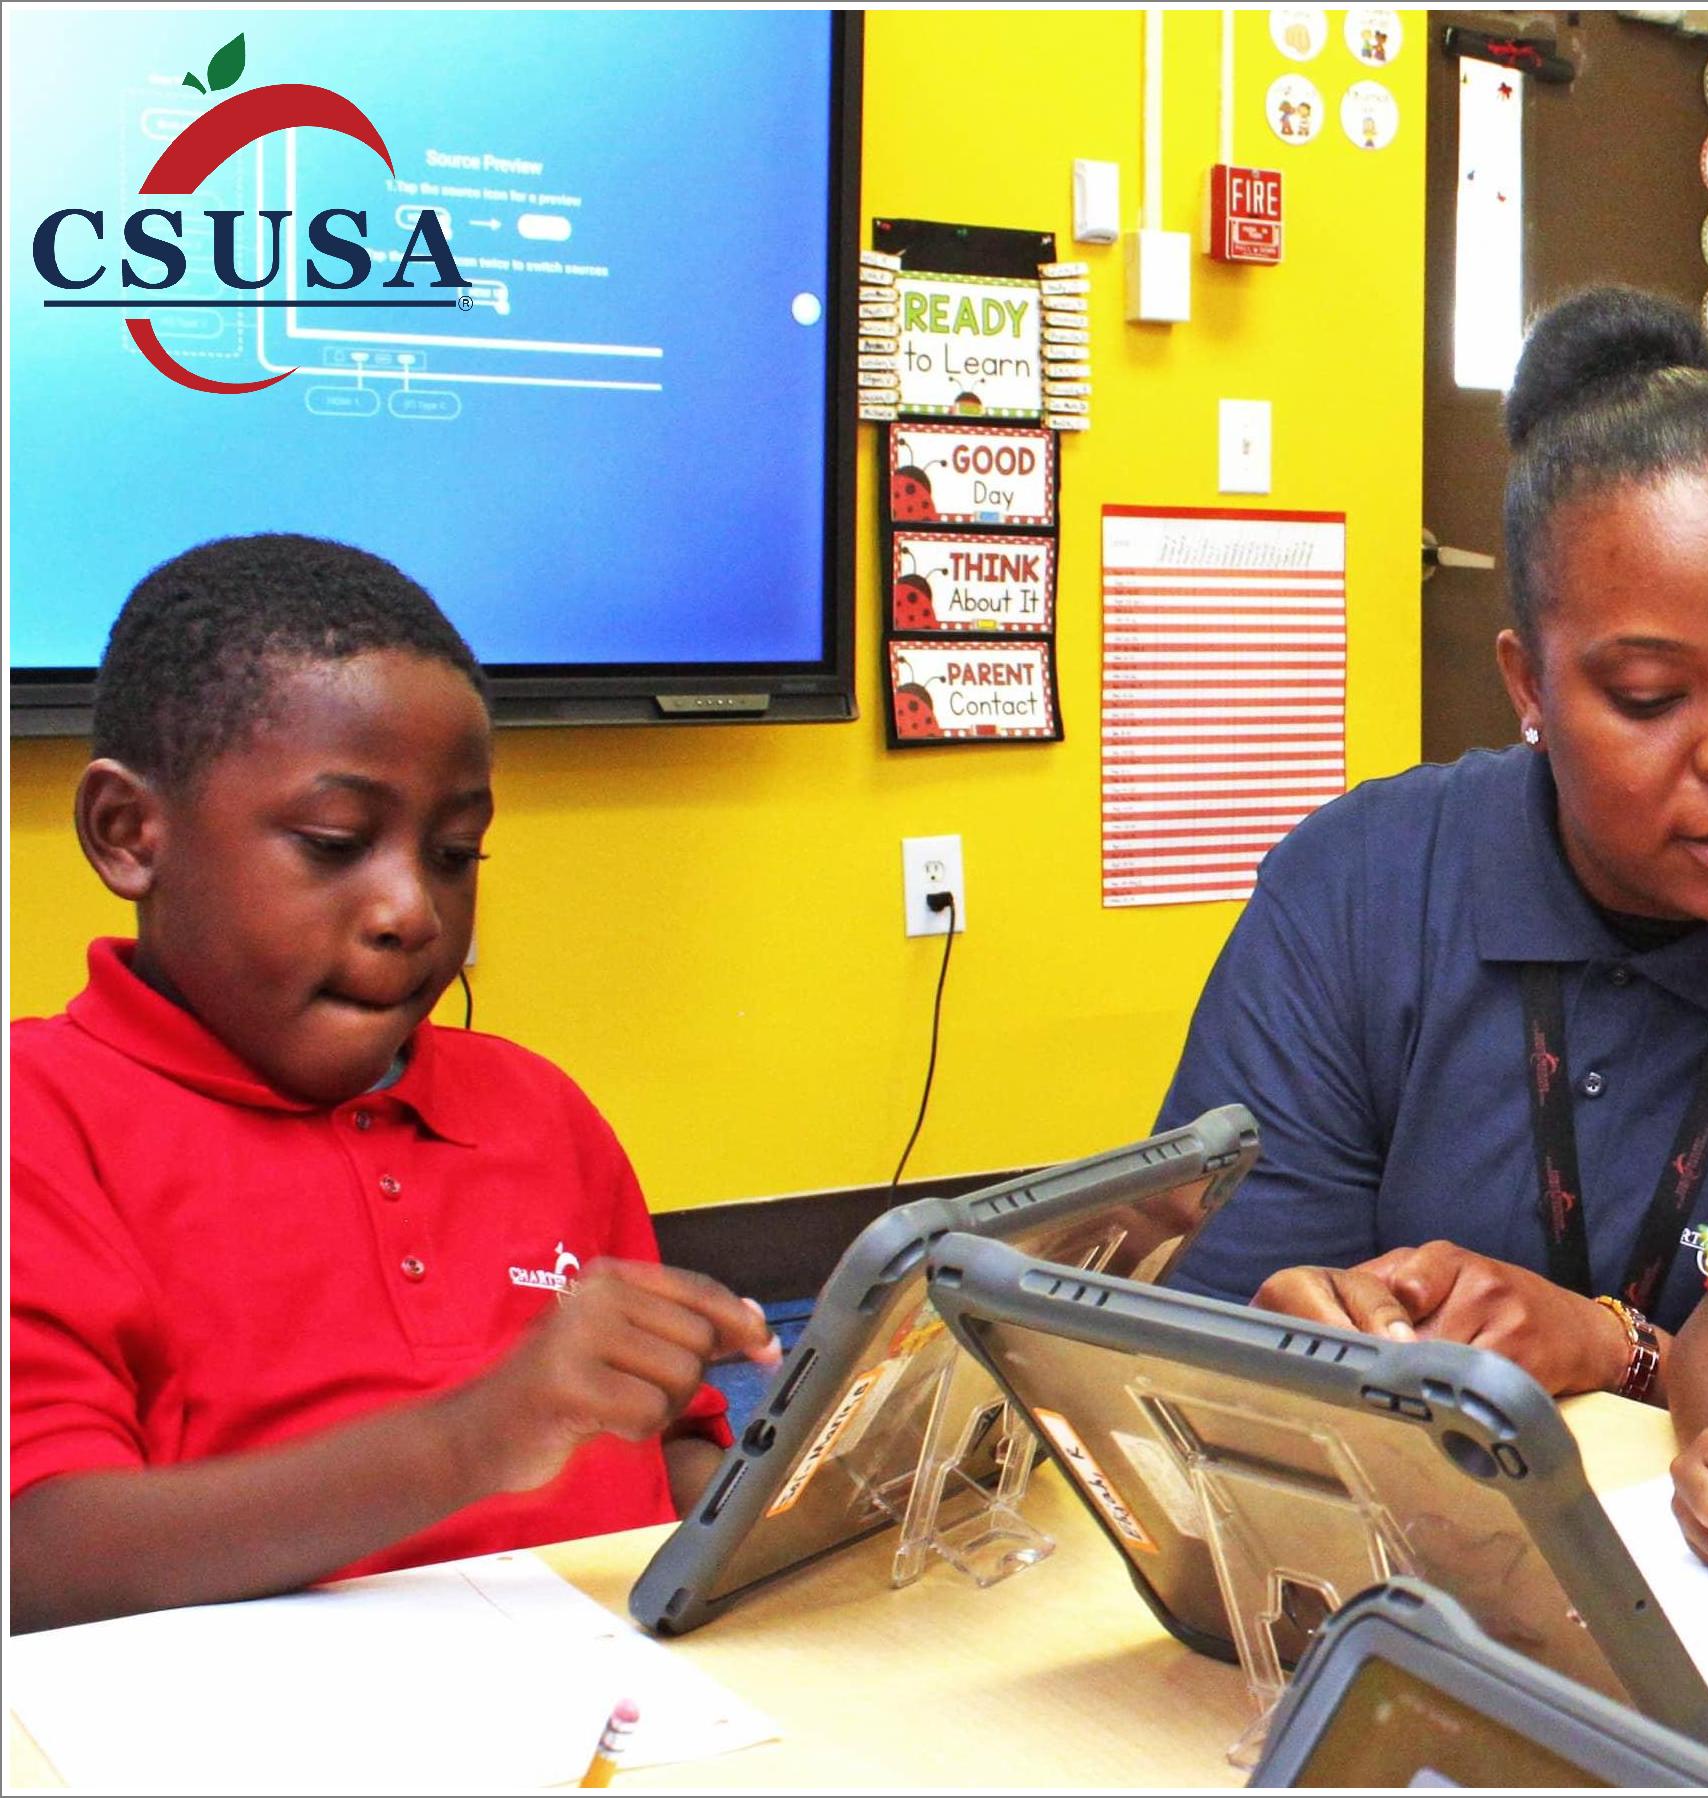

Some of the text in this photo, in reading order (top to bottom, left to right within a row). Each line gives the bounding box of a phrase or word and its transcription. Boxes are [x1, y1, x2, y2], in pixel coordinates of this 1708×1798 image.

[426, 149, 543, 176] Source Preview
[1231, 177, 1279, 217] FIRE
[904, 290, 1030, 339] READY
[904, 340, 1031, 377] to Learn
[952, 444, 1036, 476] GOOD
[974, 480, 1014, 511] Day
[949, 552, 1040, 584] THINK
[949, 587, 1040, 613] About It
[947, 662, 1035, 686] PARENT
[950, 691, 1038, 716] Contact
